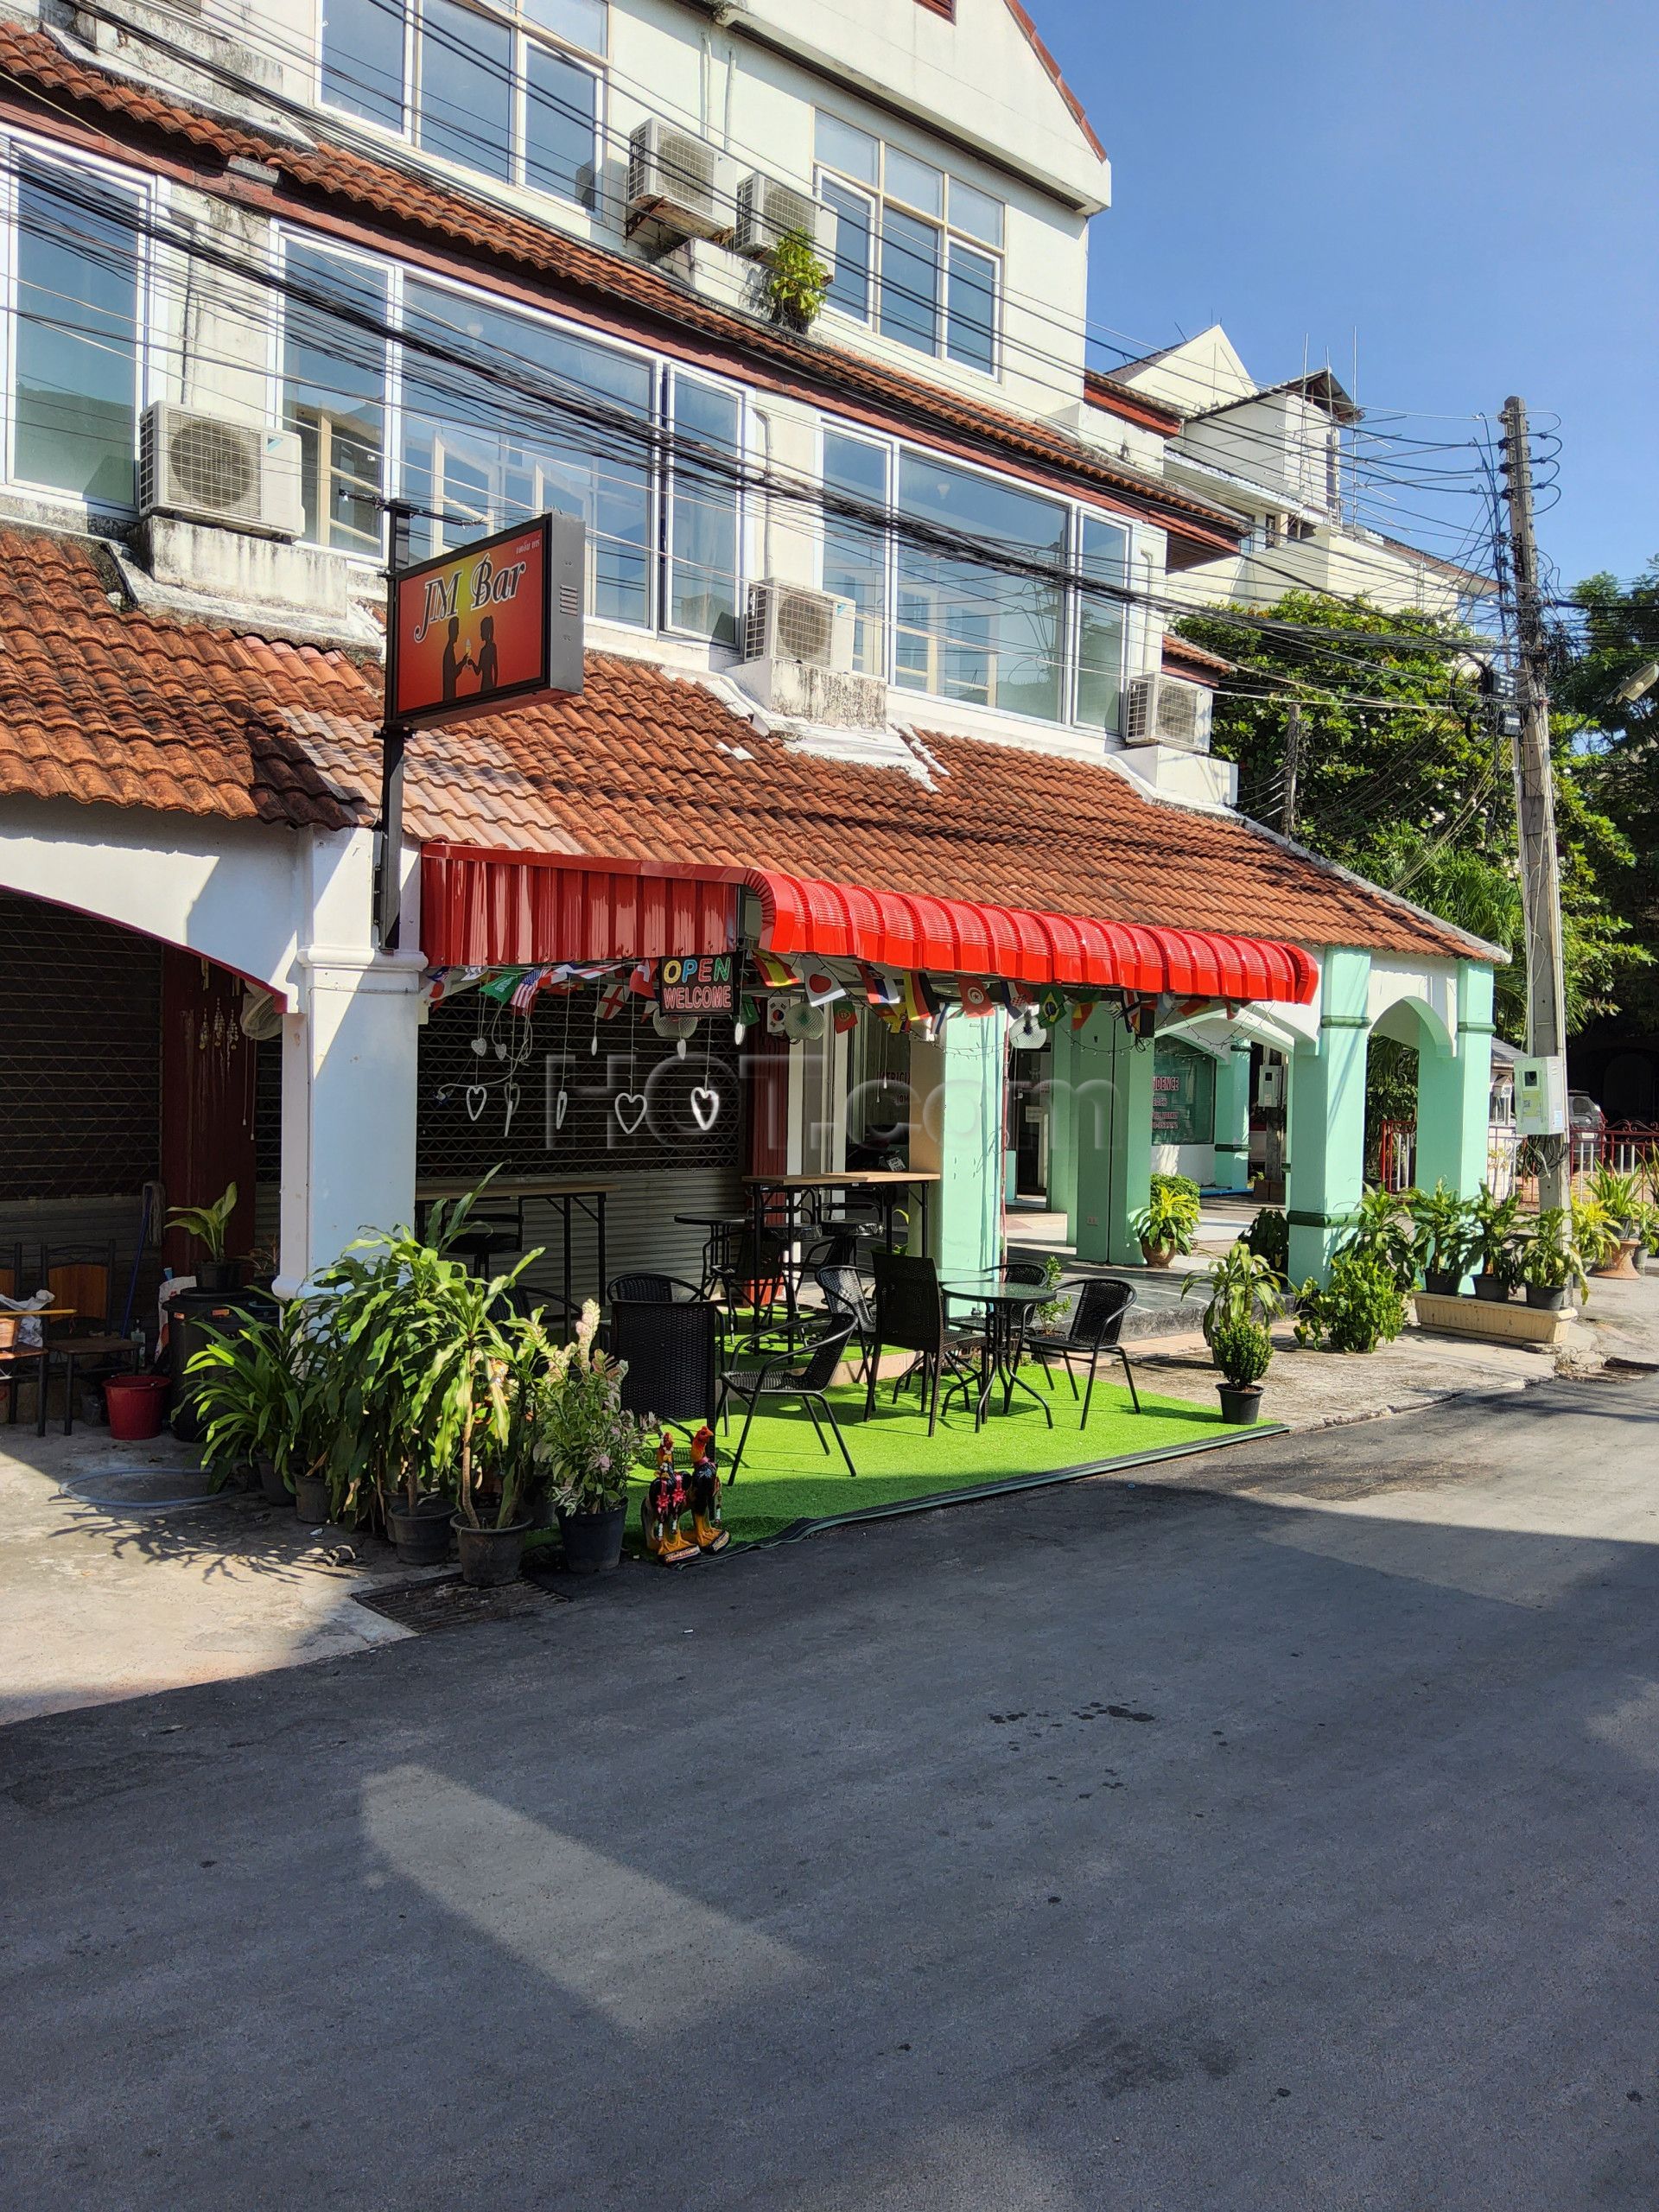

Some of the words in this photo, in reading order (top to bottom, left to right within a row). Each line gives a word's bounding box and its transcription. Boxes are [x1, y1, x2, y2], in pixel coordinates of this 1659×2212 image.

[414, 569, 462, 643] JM
[471, 553, 526, 611] Bar
[663, 957, 731, 984] OPEN
[663, 985, 732, 1010] WELCOME
[1153, 1077, 1179, 1090] IDENCE
